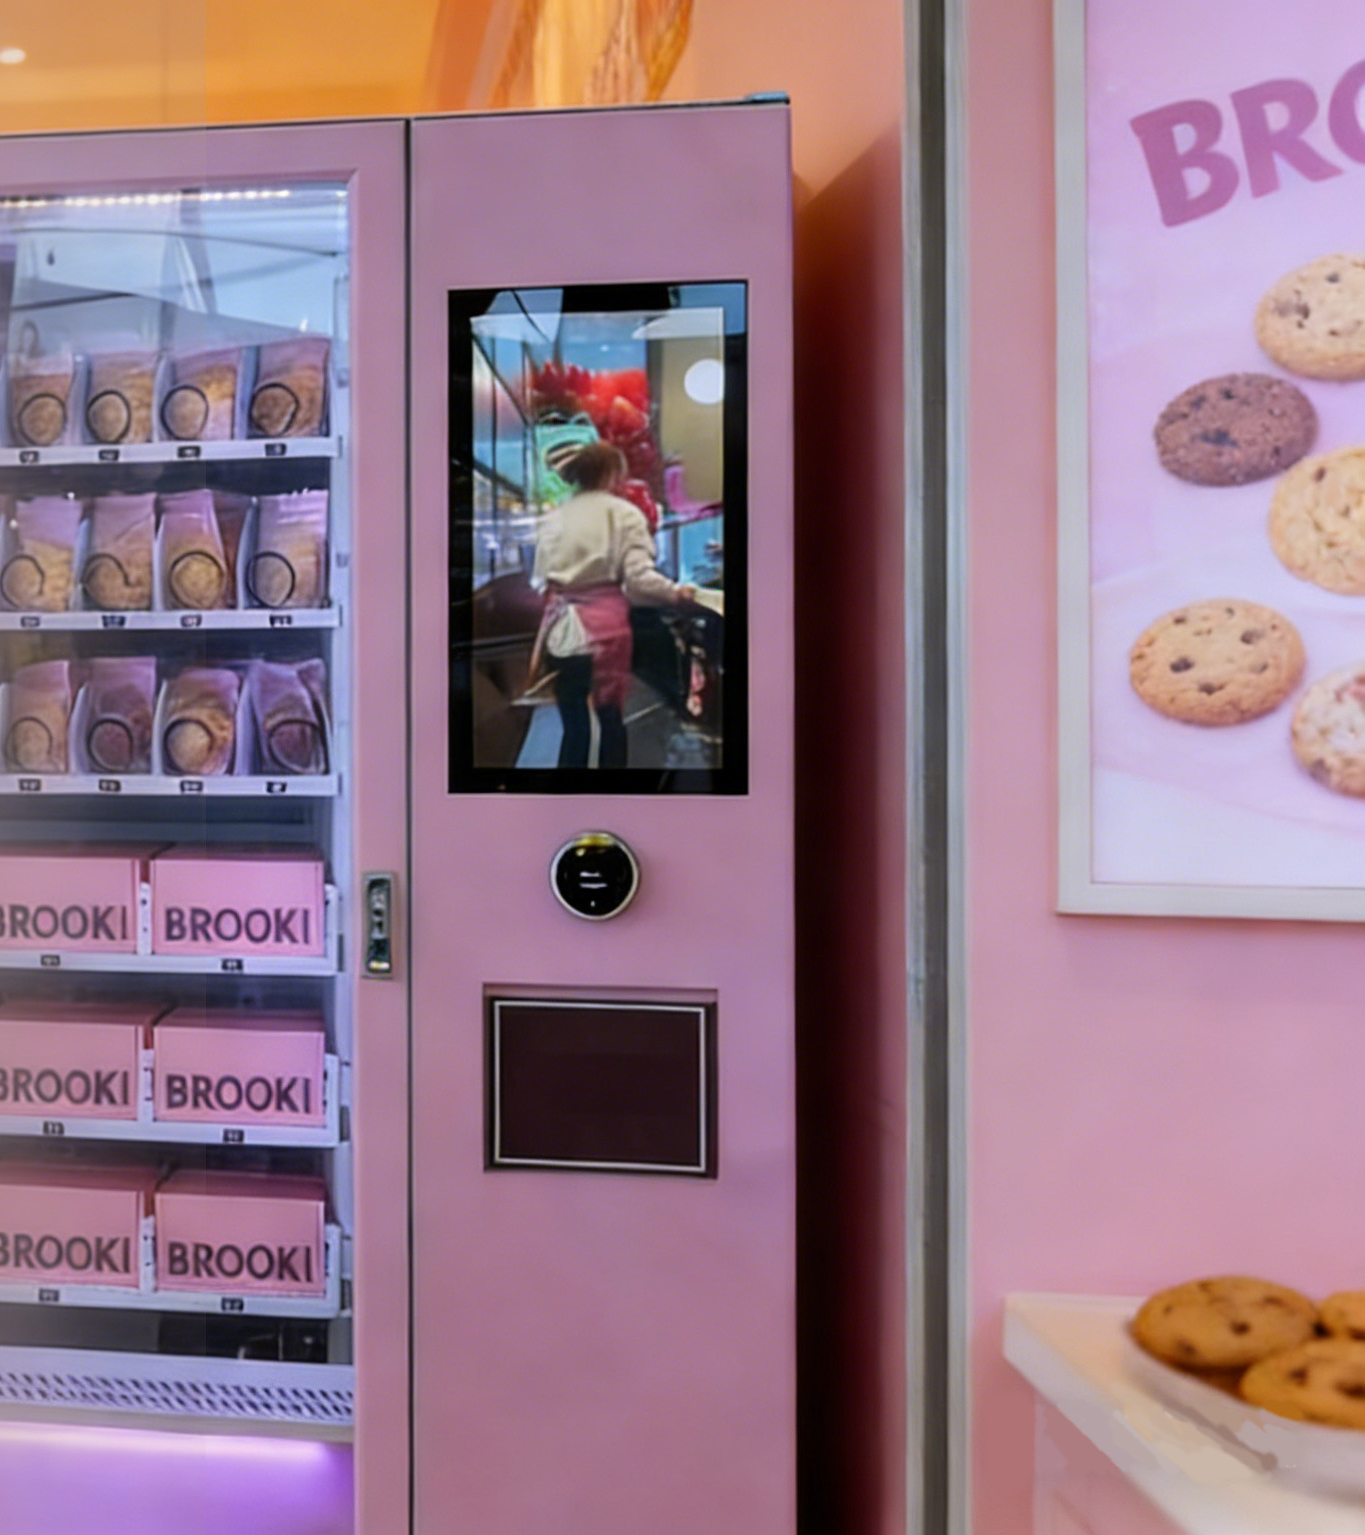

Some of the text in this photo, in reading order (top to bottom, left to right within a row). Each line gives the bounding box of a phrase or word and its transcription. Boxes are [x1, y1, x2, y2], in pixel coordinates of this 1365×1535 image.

[164, 907, 310, 945] BROOKI
[165, 1073, 312, 1114] BROOKI
[167, 1241, 313, 1283] BROOKI
